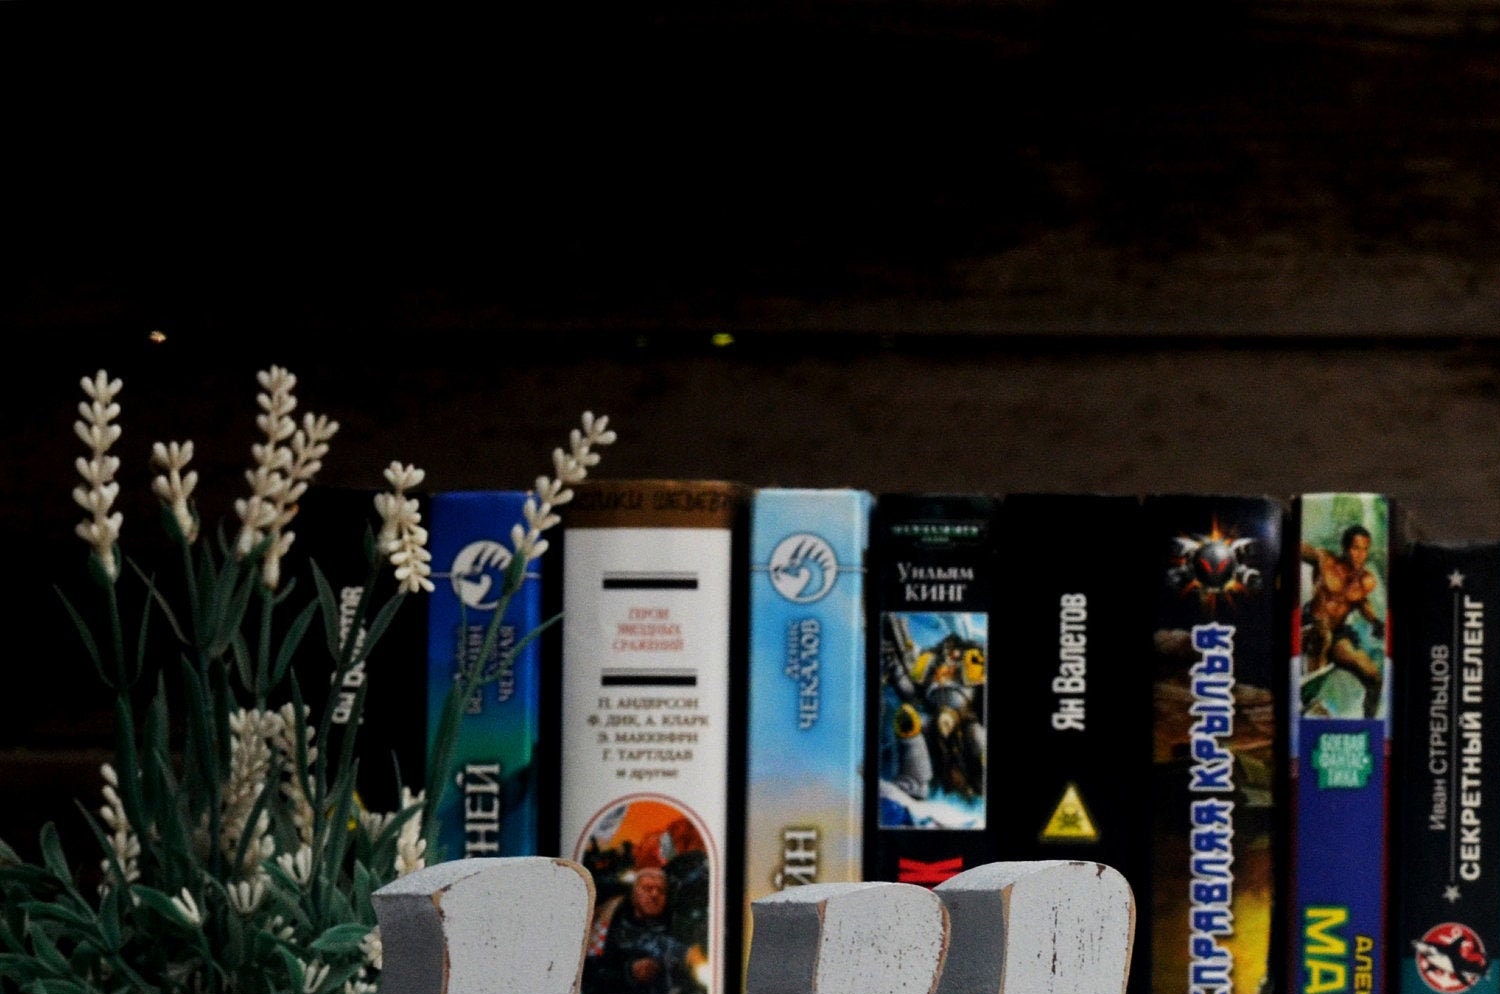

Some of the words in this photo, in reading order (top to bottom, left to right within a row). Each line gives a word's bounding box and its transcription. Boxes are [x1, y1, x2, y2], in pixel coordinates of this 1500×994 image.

[905, 584, 967, 602] КИНГ
[798, 618, 819, 729] ЧЕКАЛОВ
[1051, 592, 1087, 694] Валетов
[1462, 596, 1484, 704] ПЕЛЕНГ
[617, 697, 699, 710] АНДЕРСОН
[661, 714, 710, 728] КЛАРК
[1051, 698, 1086, 731] Ян
[1188, 622, 1236, 792] КРЫЛЬЯ
[1428, 644, 1451, 775] СТРЕЛЬЦОВ
[456, 763, 500, 857] НЕЙ
[629, 766, 679, 782] другие
[1428, 778, 1448, 831] Иван
[1458, 712, 1484, 881] СЕКРЕТНЫЙ
